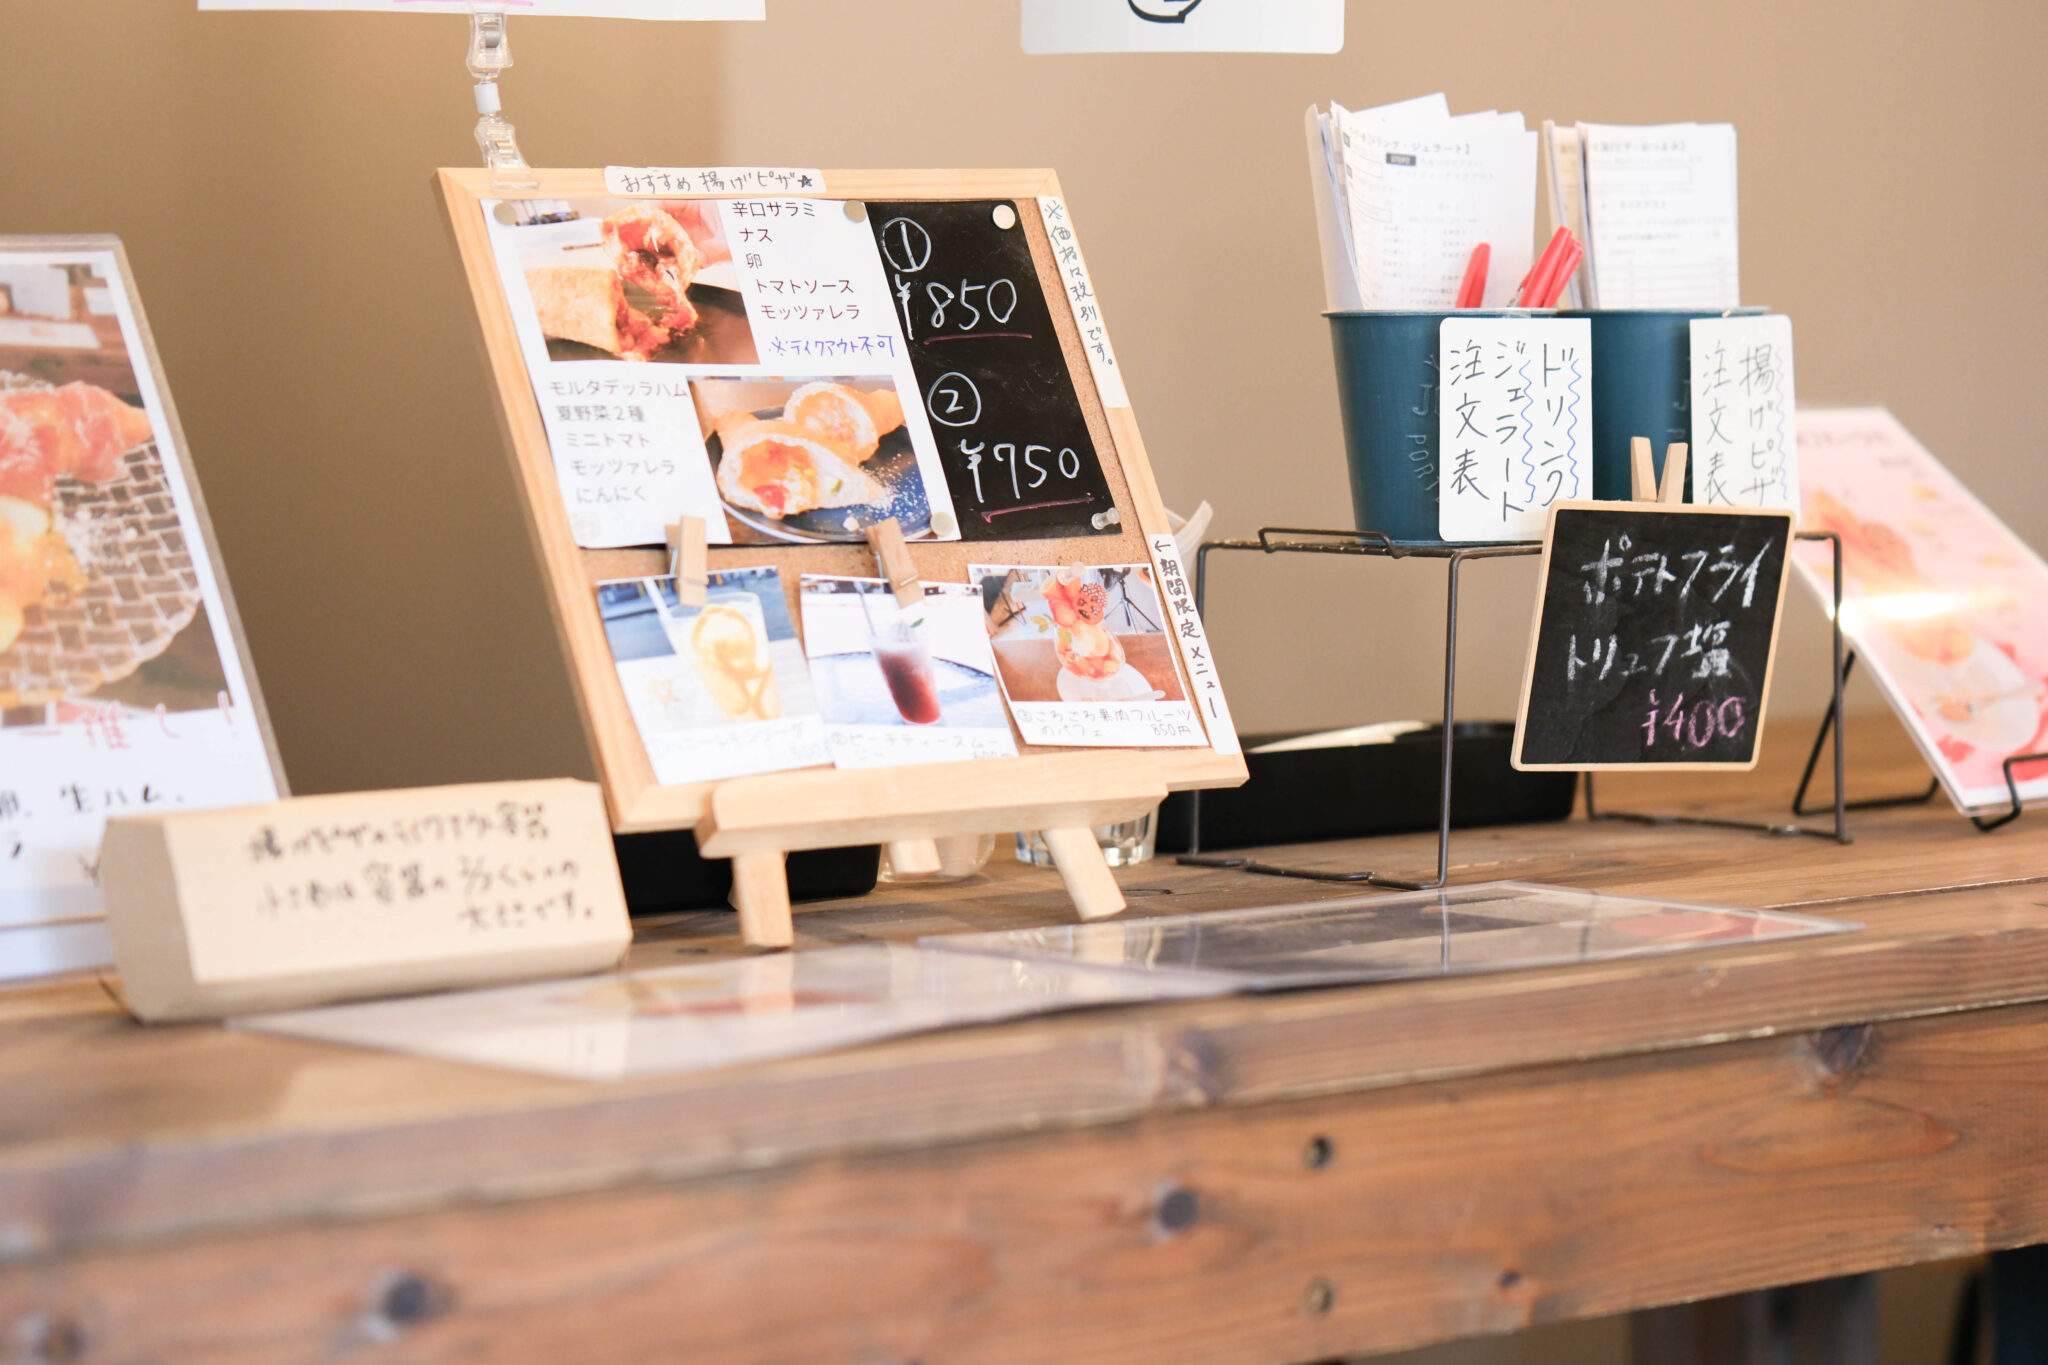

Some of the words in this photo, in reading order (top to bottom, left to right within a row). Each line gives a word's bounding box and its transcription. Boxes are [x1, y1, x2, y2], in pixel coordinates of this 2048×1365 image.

[732, 201, 815, 217] 辛口サラミ
[739, 227, 773, 242] ナス
[745, 252, 763, 269] 卵
[755, 279, 854, 294] トマトソース
[760, 304, 860, 320] モッツァレラ
[894, 273, 1018, 341] ¥850
[550, 379, 689, 397] モルタデッラハム
[565, 431, 652, 448] ミニトマト
[1450, 339, 1490, 500] 注文表
[1494, 340, 1527, 522] ジェラート
[1540, 342, 1574, 507] ドリンク
[1702, 339, 1736, 506] 注文表
[1738, 343, 1779, 506] 揚げピザ
[571, 458, 676, 476] モッツァレラ
[576, 485, 647, 504] にんにく
[1580, 533, 1775, 608] ポテトフライ
[1160, 558, 1218, 719] 期間限定メニュー
[1566, 620, 1734, 681] トリュフ塩
[1640, 688, 1747, 747] ¥400
